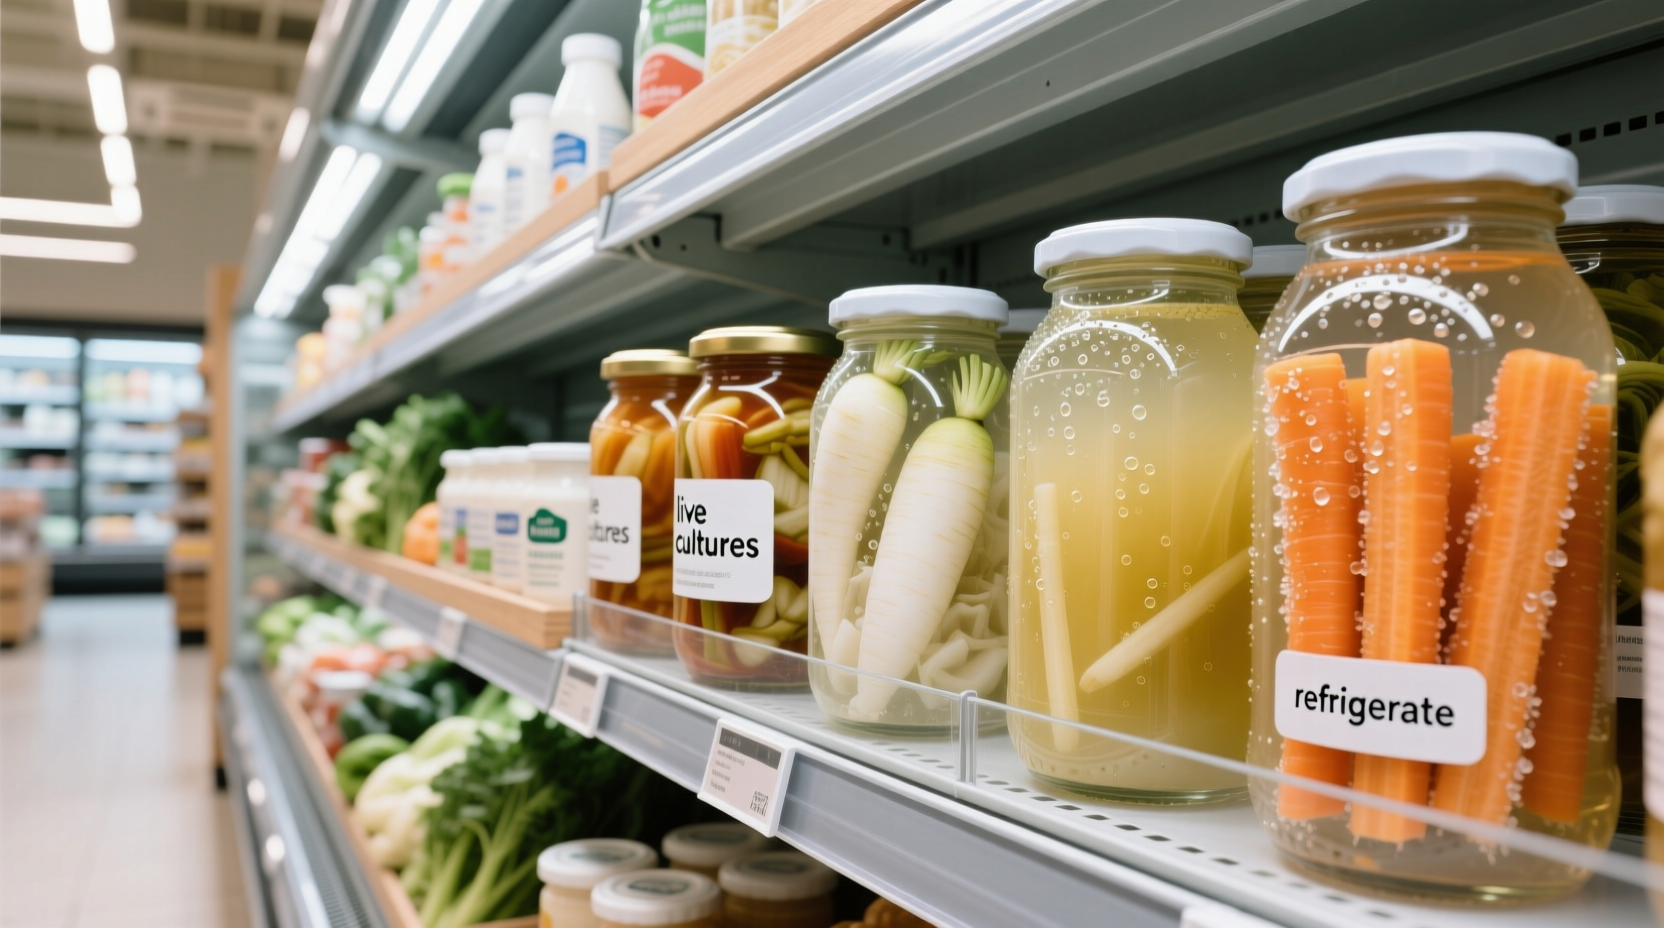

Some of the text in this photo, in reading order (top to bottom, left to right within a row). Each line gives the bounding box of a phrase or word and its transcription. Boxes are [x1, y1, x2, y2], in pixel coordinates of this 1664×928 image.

[677, 495, 707, 524] live
[589, 520, 629, 544] tures
[676, 528, 759, 558] cultures
[1295, 684, 1455, 727] refrigerate
